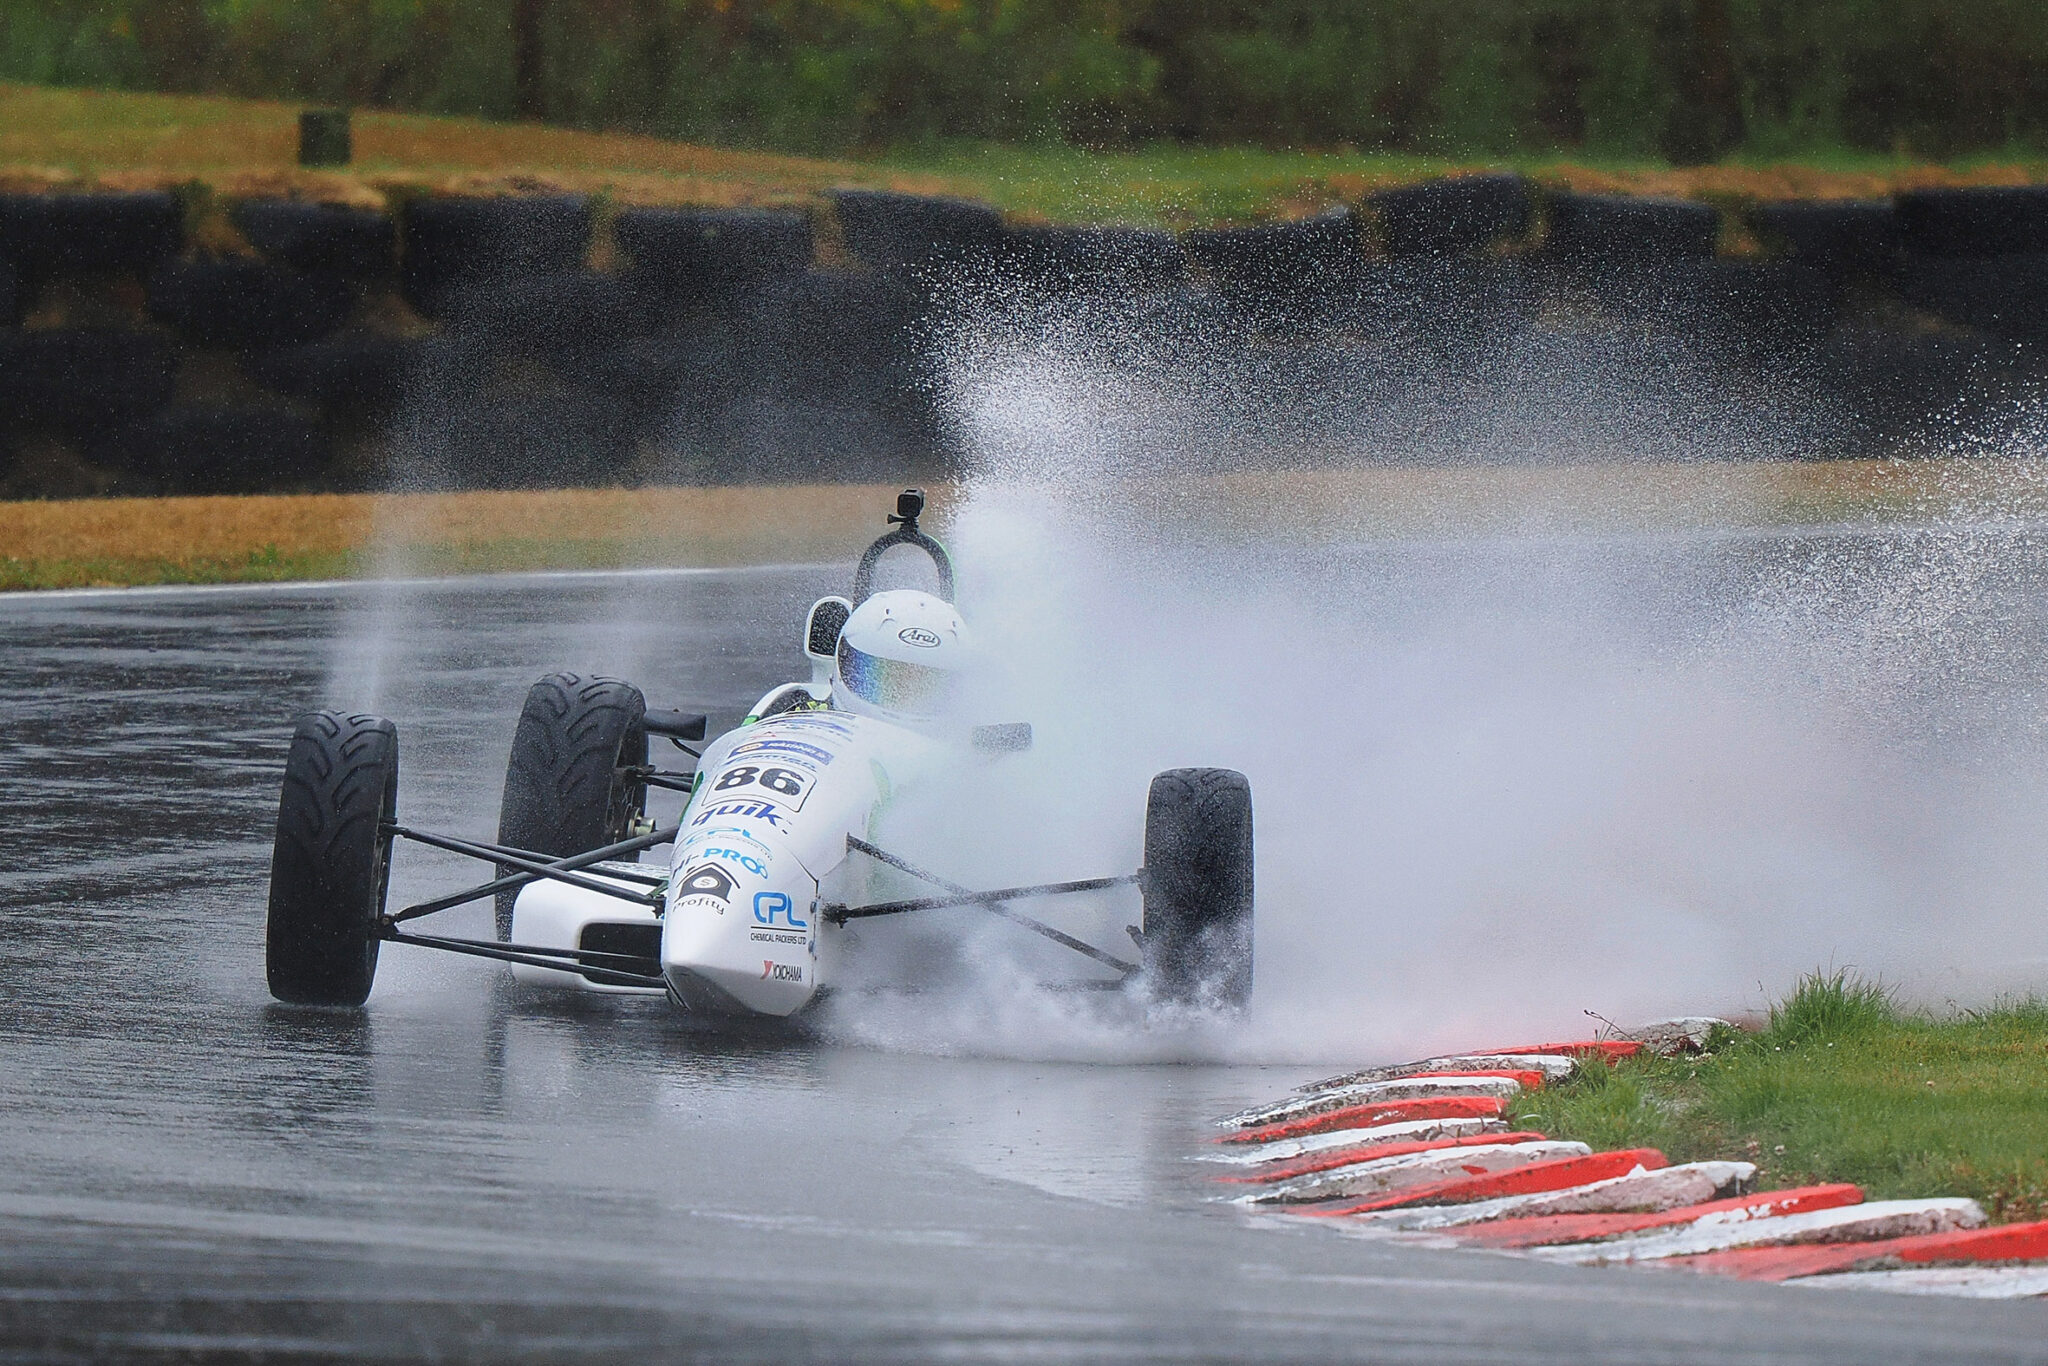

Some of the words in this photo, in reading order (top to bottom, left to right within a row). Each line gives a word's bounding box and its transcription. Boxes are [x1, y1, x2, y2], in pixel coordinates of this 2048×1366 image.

[902, 630, 936, 644] Arai
[714, 766, 805, 796] 86
[692, 800, 784, 827] quik
[752, 891, 808, 928] CPL
[750, 932, 775, 943] CHEMICAL
[775, 934, 797, 945] PACKERS
[798, 936, 807, 946] LTD
[772, 960, 802, 982] YOKOHAMA
